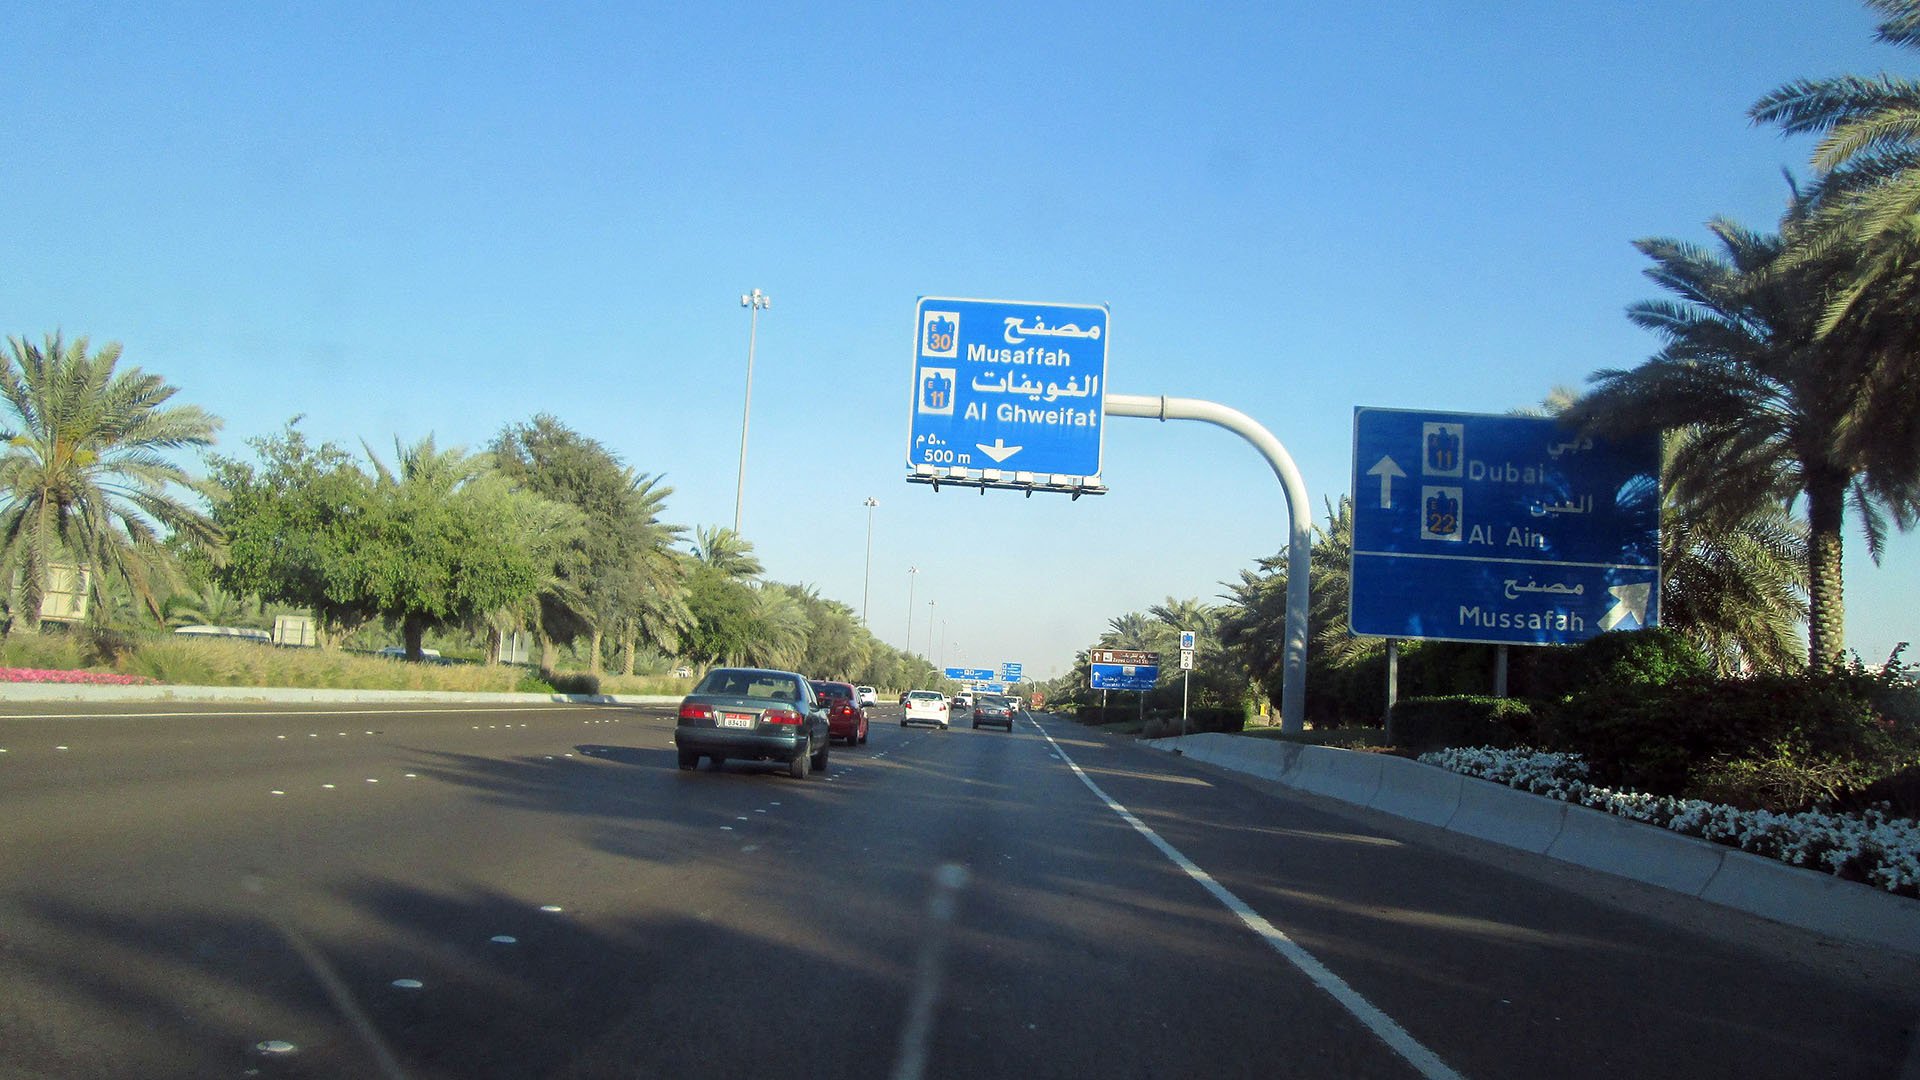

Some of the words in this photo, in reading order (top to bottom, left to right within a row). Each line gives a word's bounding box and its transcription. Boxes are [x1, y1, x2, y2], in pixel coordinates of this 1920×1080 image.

[930, 333, 951, 350] 30
[1003, 315, 1100, 344] مصفح
[967, 343, 1071, 367] Musaffah
[971, 370, 1098, 402] الغويفات
[930, 391, 944, 407] 11
[964, 402, 987, 421] Al
[996, 403, 1097, 427] Ghweifat
[924, 449, 953, 463] 500
[957, 452, 971, 464] m
[1437, 450, 1452, 466] 11
[1468, 461, 1544, 484] Dubai
[1530, 493, 1593, 518] العين
[1430, 513, 1454, 532] 22
[1468, 524, 1493, 545] Al
[1506, 527, 1544, 548] Ain
[1503, 576, 1584, 600] مصفح
[1459, 606, 1584, 632] Mussafah
